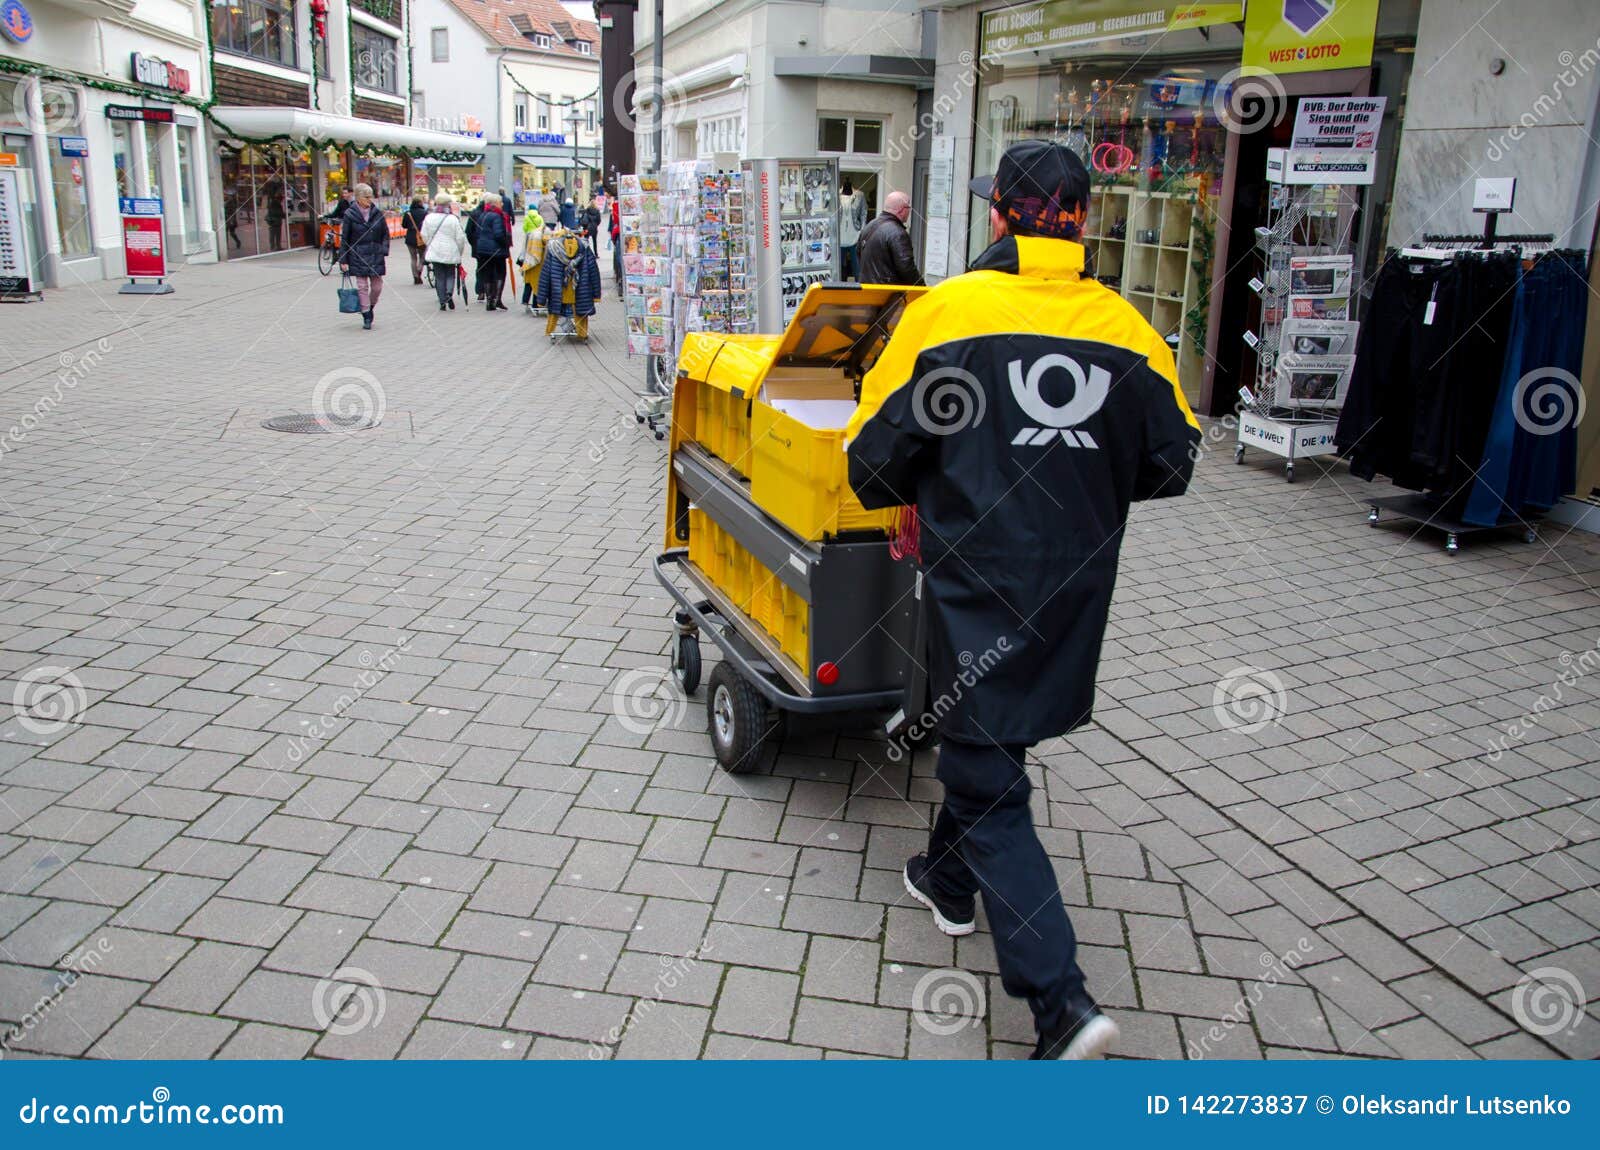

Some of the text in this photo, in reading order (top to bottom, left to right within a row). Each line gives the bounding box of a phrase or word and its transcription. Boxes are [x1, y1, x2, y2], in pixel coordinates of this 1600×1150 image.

[986, 15, 1008, 34] LOTTO
[1103, 9, 1165, 32] GESCHENKARTIKEL
[1269, 44, 1341, 63] WEST LOTTO
[1304, 101, 1380, 112] BVB: Der Derby-
[1309, 113, 1370, 124] Sieg und die
[1318, 125, 1356, 135] Folgen!
[514, 131, 567, 145] SCHUHPARK
[1244, 424, 1256, 436] DIE
[1301, 437, 1316, 447] DIE
